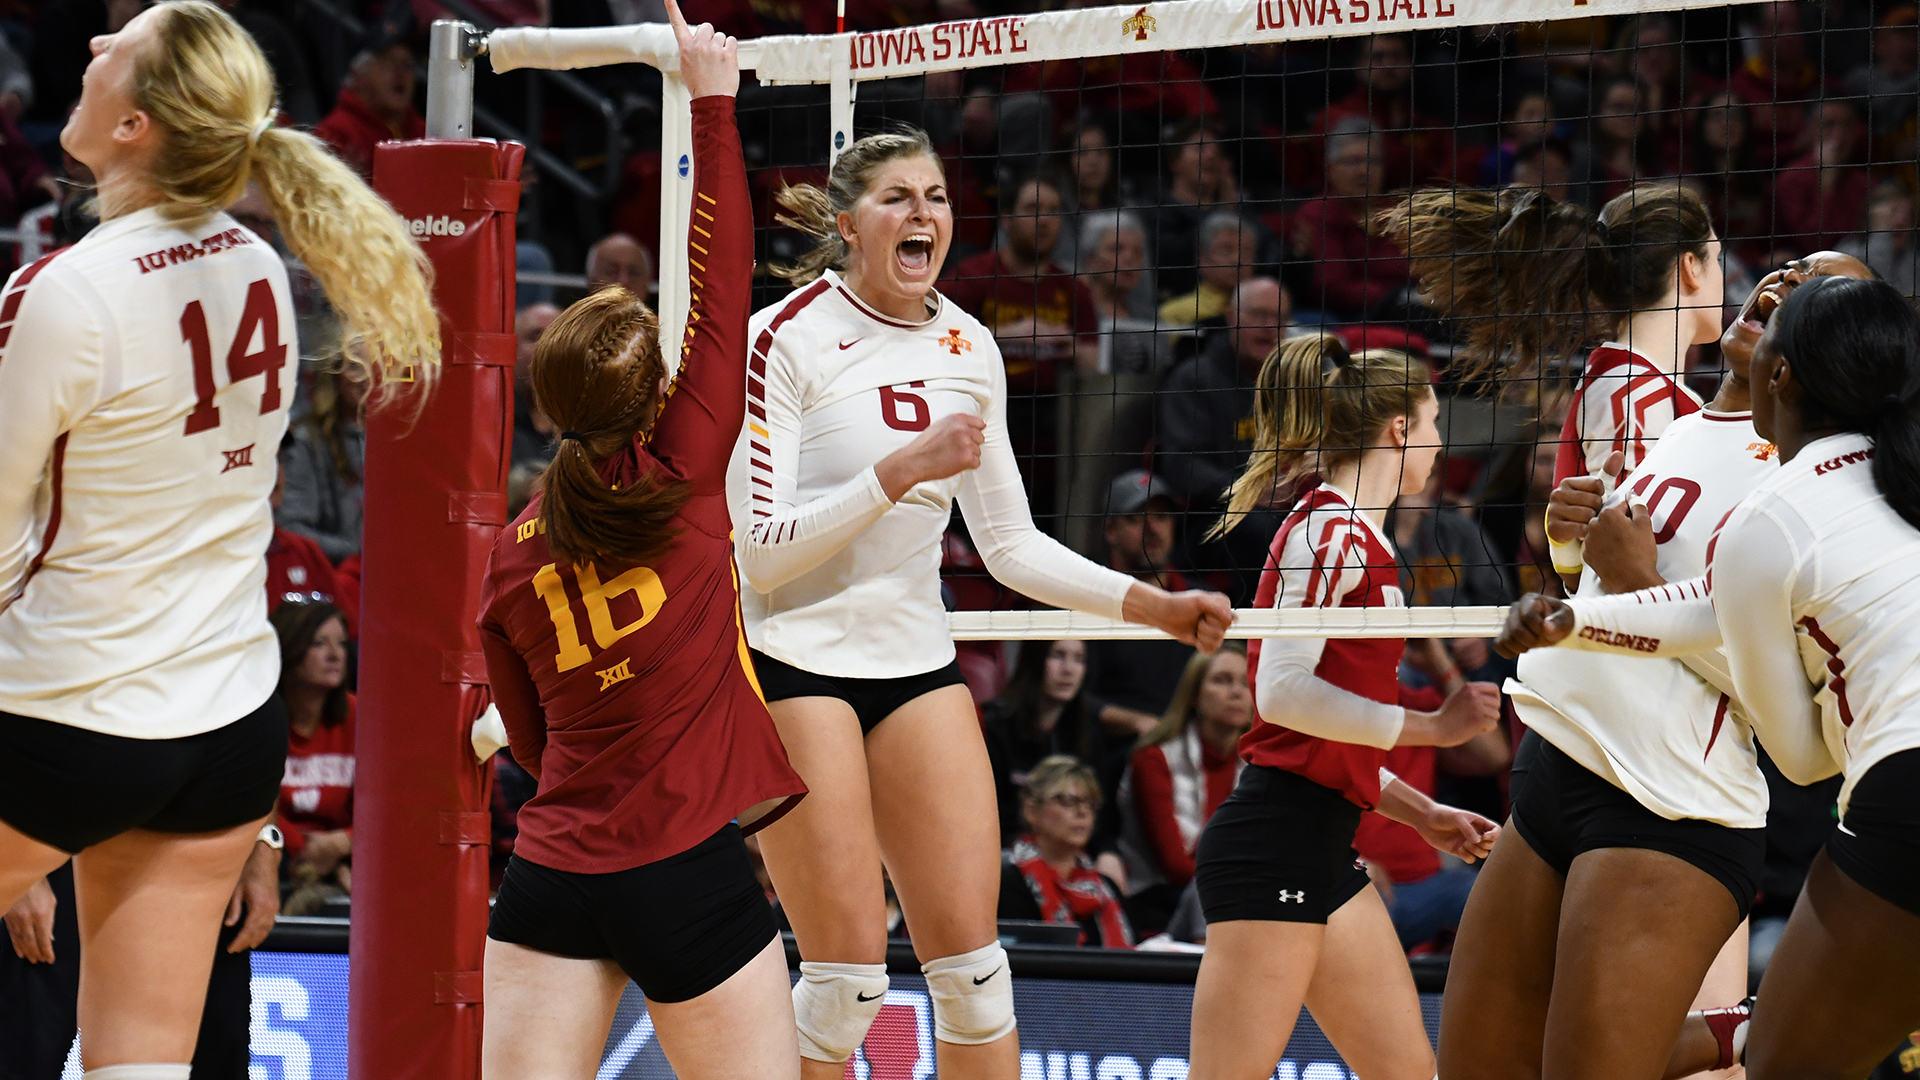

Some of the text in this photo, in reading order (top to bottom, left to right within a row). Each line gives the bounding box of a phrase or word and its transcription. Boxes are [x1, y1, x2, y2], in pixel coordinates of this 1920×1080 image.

[1122, 15, 1157, 36] STATE
[1256, 0, 1343, 30] IOWA
[850, 17, 1028, 69] IOWA STATE
[132, 243, 205, 274] IOWA
[179, 278, 288, 436] 14
[878, 380, 931, 432] 6
[220, 443, 255, 475] XII
[1745, 442, 1780, 459] STAT
[531, 556, 667, 673] 16
[1578, 625, 1661, 653] CYCLONES
[595, 657, 635, 692] XII
